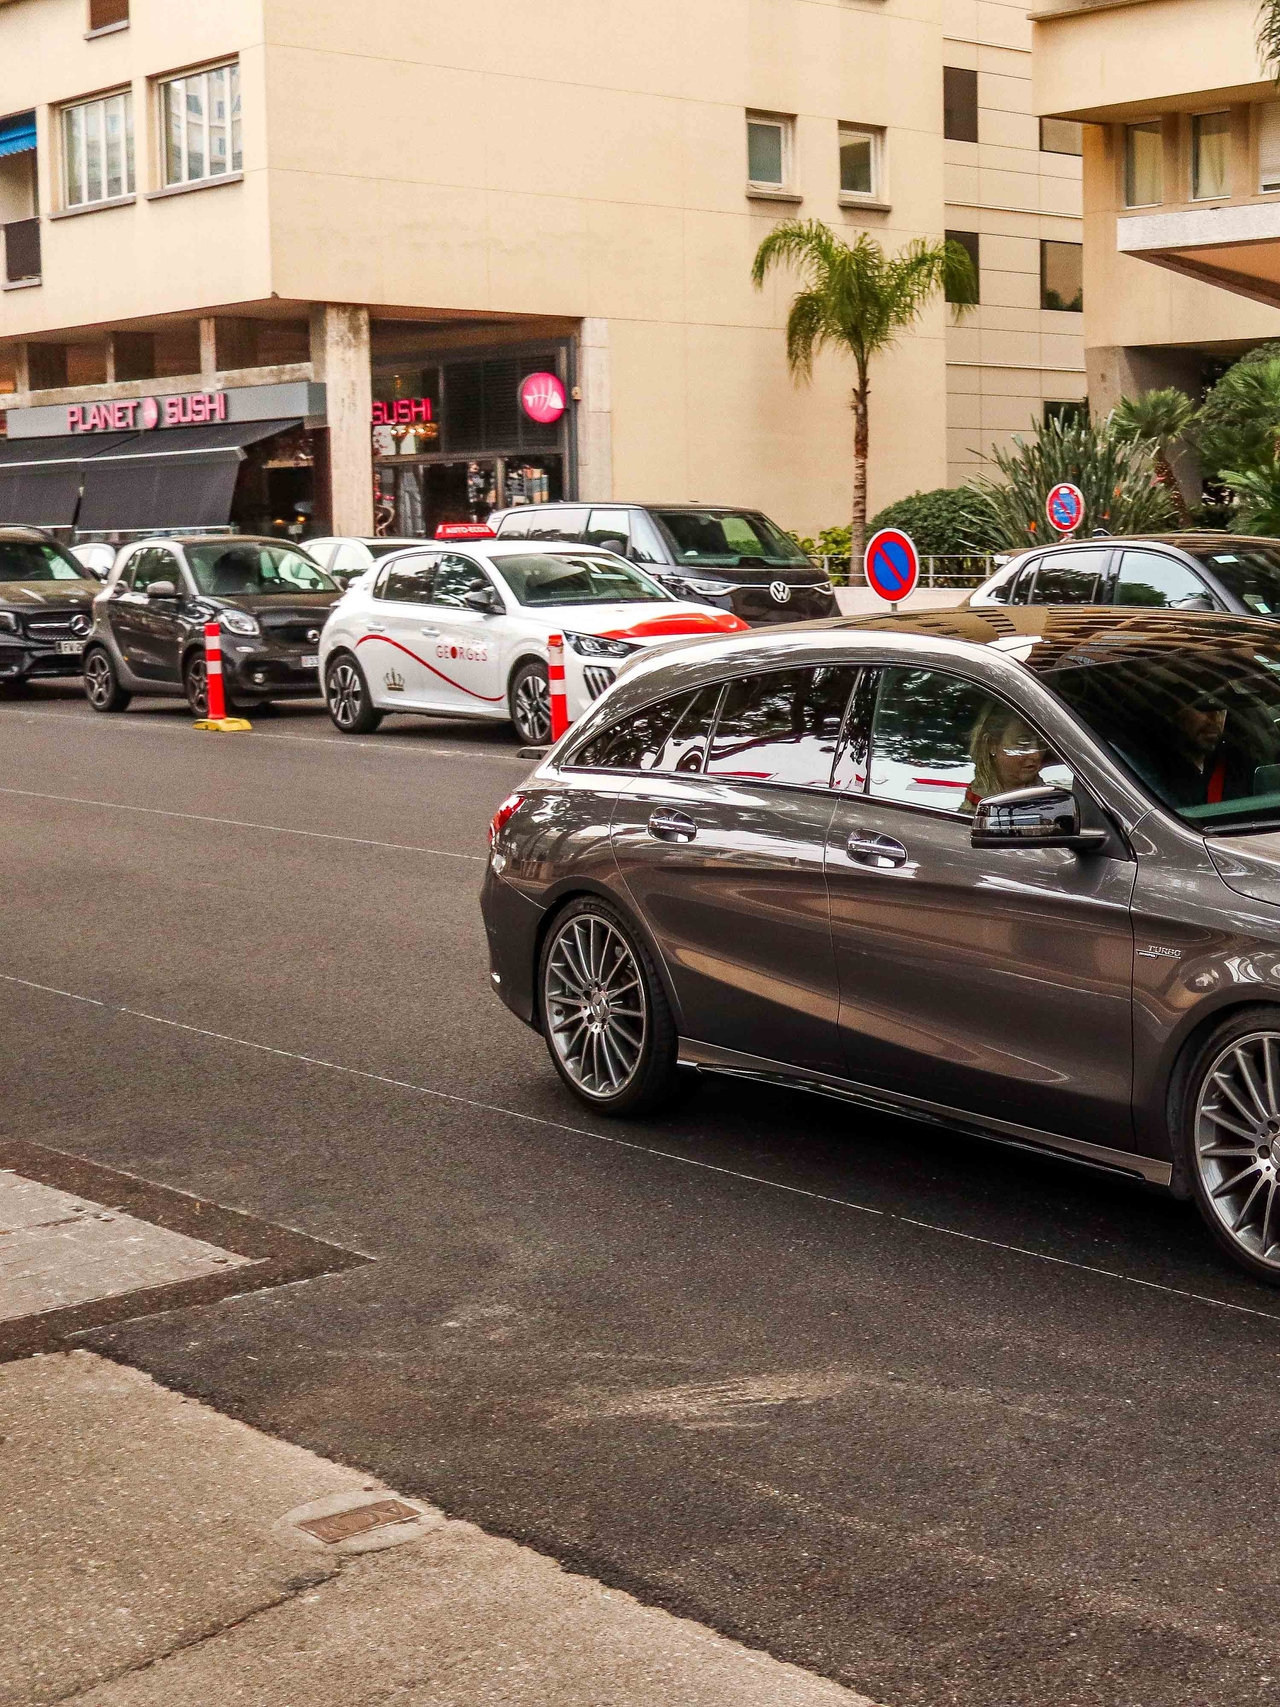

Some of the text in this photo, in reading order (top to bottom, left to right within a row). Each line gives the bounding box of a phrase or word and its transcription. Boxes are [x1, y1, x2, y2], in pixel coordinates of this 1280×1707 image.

[67, 393, 227, 431] PLANET SUSHI
[372, 397, 433, 424] SUSHI
[436, 645, 488, 661] GEORGES
[1148, 945, 1181, 956] TURBO
